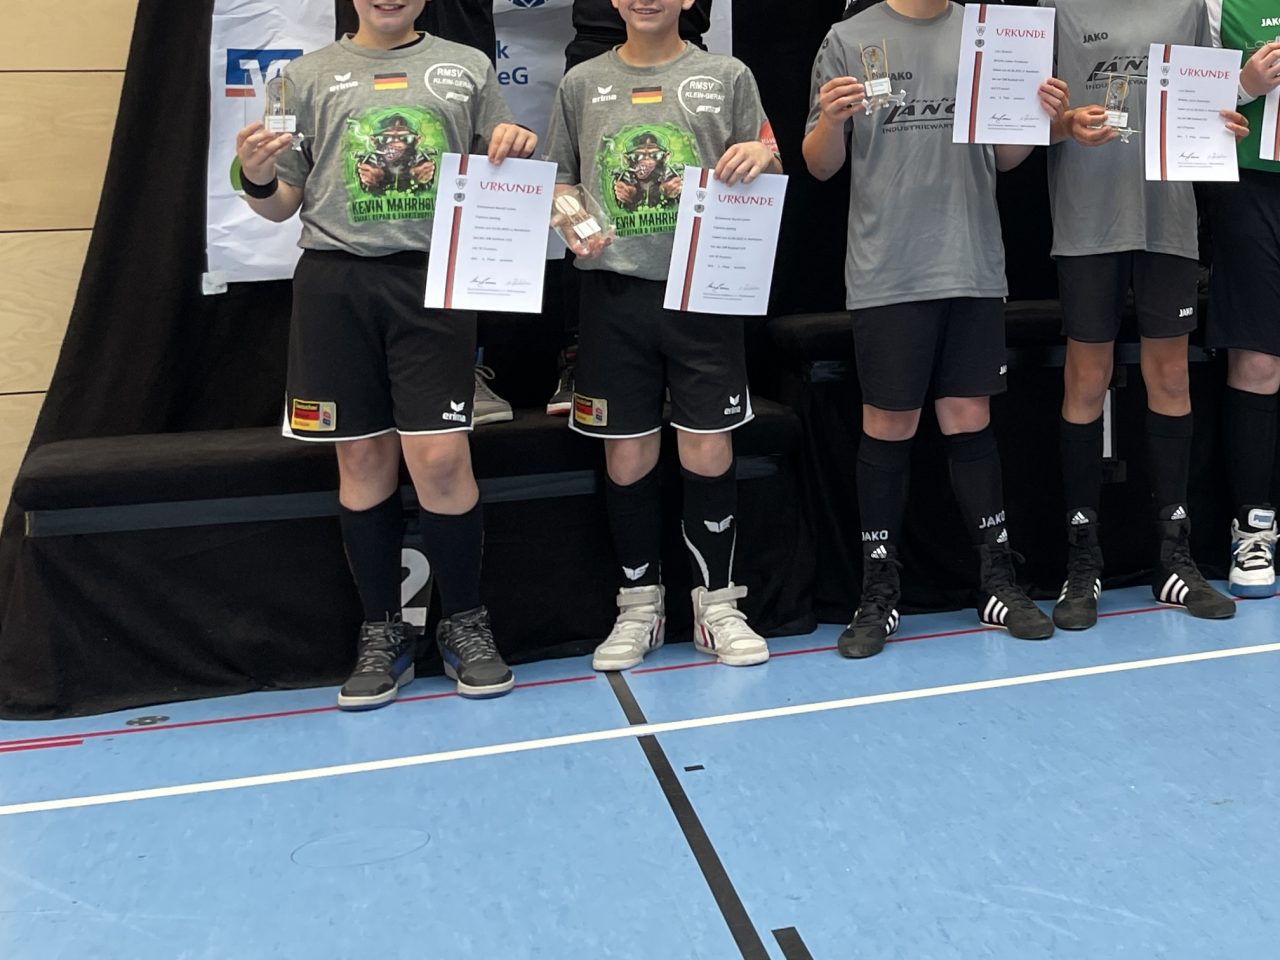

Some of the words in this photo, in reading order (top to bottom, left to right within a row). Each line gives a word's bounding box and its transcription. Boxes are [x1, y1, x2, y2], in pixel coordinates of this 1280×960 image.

[996, 28, 1047, 39] URKUNDE
[1082, 32, 1109, 43] JAKO
[437, 68, 464, 79] RMSV
[1180, 67, 1231, 80] URKUNDE
[689, 81, 716, 91] RMSV
[480, 181, 544, 195] URKUNDE
[718, 194, 776, 207] URKUNDE
[352, 199, 383, 215] KEVIN
[442, 412, 467, 423] erima
[978, 510, 1006, 529] JAKO
